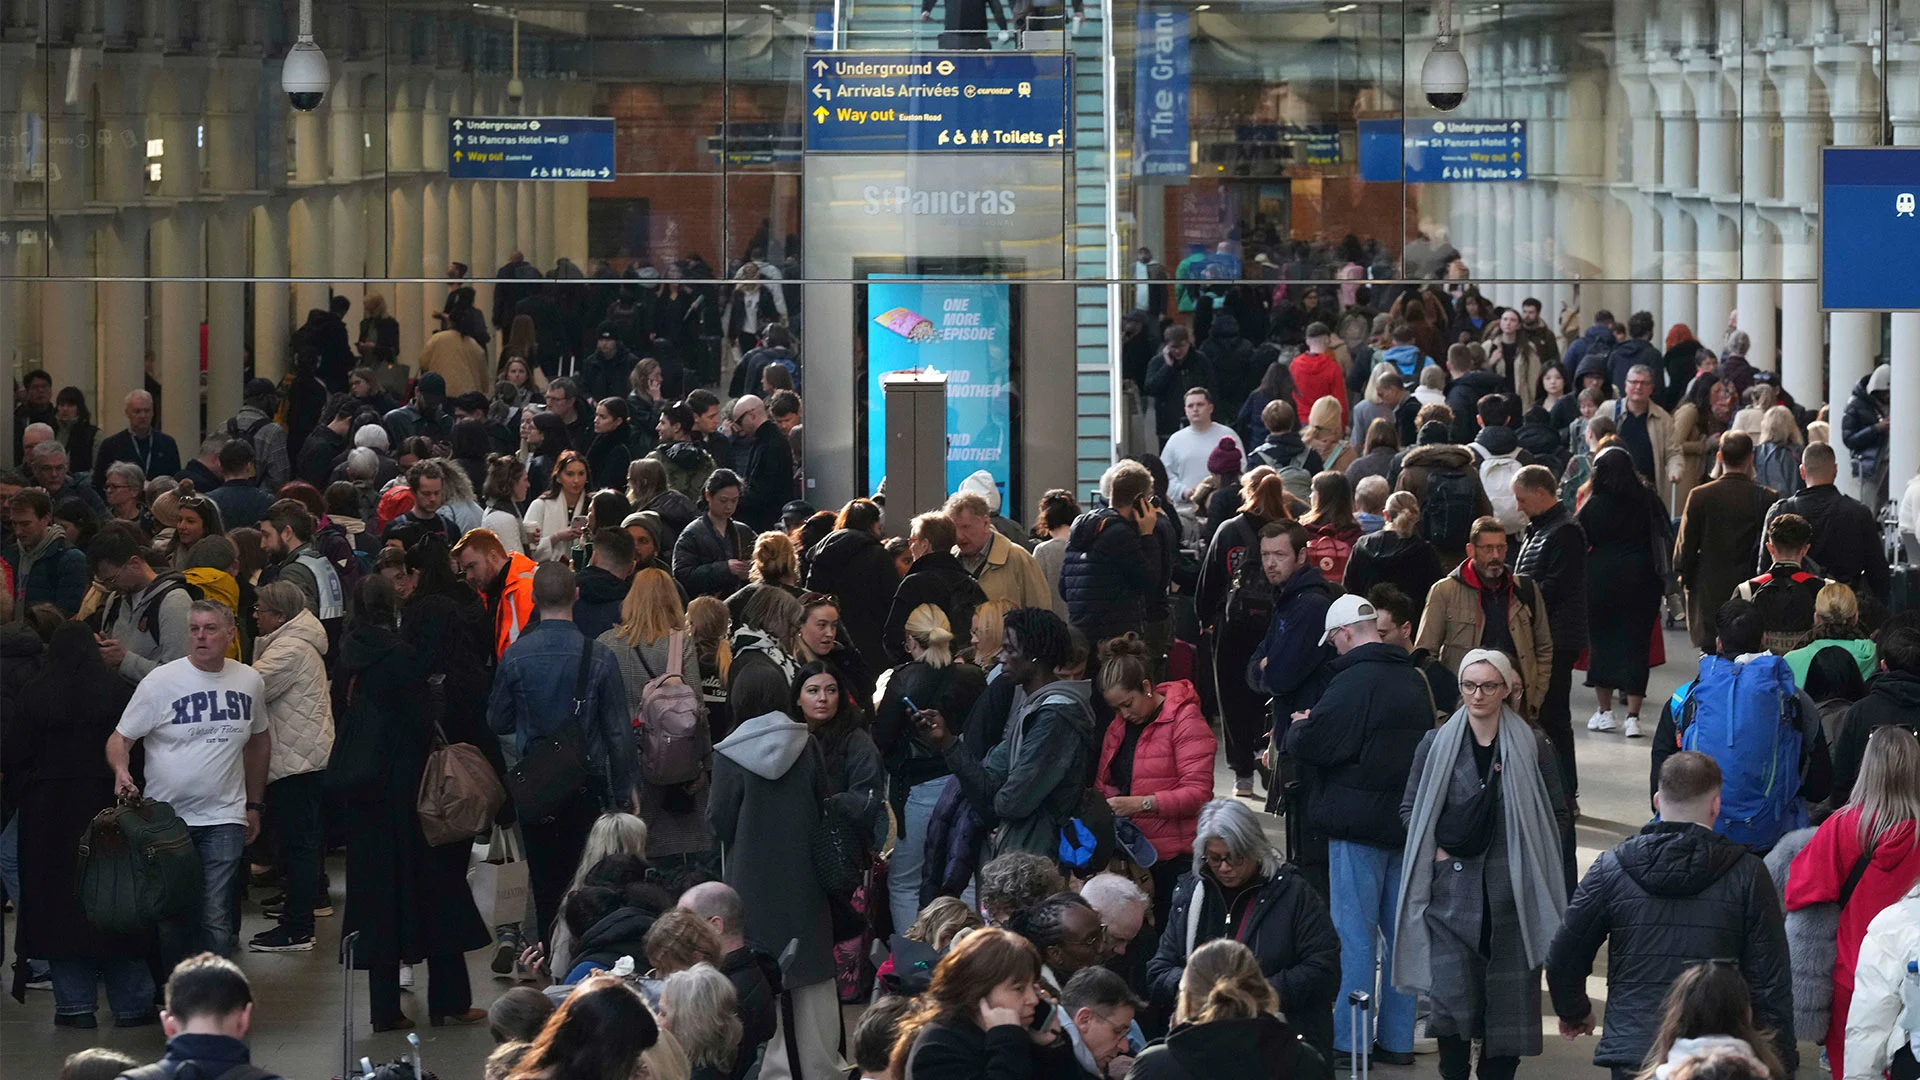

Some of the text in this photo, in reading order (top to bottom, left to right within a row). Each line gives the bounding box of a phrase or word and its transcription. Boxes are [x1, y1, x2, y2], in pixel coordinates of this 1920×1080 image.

[835, 61, 932, 78] Underground
[837, 84, 897, 97] Arrivals
[898, 82, 959, 97] Arrivées
[837, 108, 867, 124] Way
[870, 109, 895, 121] out
[1152, 89, 1174, 139] The
[467, 121, 527, 132] Underground
[1447, 123, 1507, 134] Underground
[467, 135, 542, 145] St Pancras Hotel
[993, 130, 1043, 144] Toilets
[1431, 138, 1442, 148] St
[1444, 138, 1480, 148] Pancras
[468, 152, 487, 163] Way
[489, 152, 504, 161] out
[1470, 153, 1490, 164] Way
[565, 168, 596, 178] Toilets
[943, 298, 970, 312] ONE
[943, 313, 981, 326] MORE
[943, 327, 996, 341] EPISODE
[172, 690, 252, 724] XPLSV
